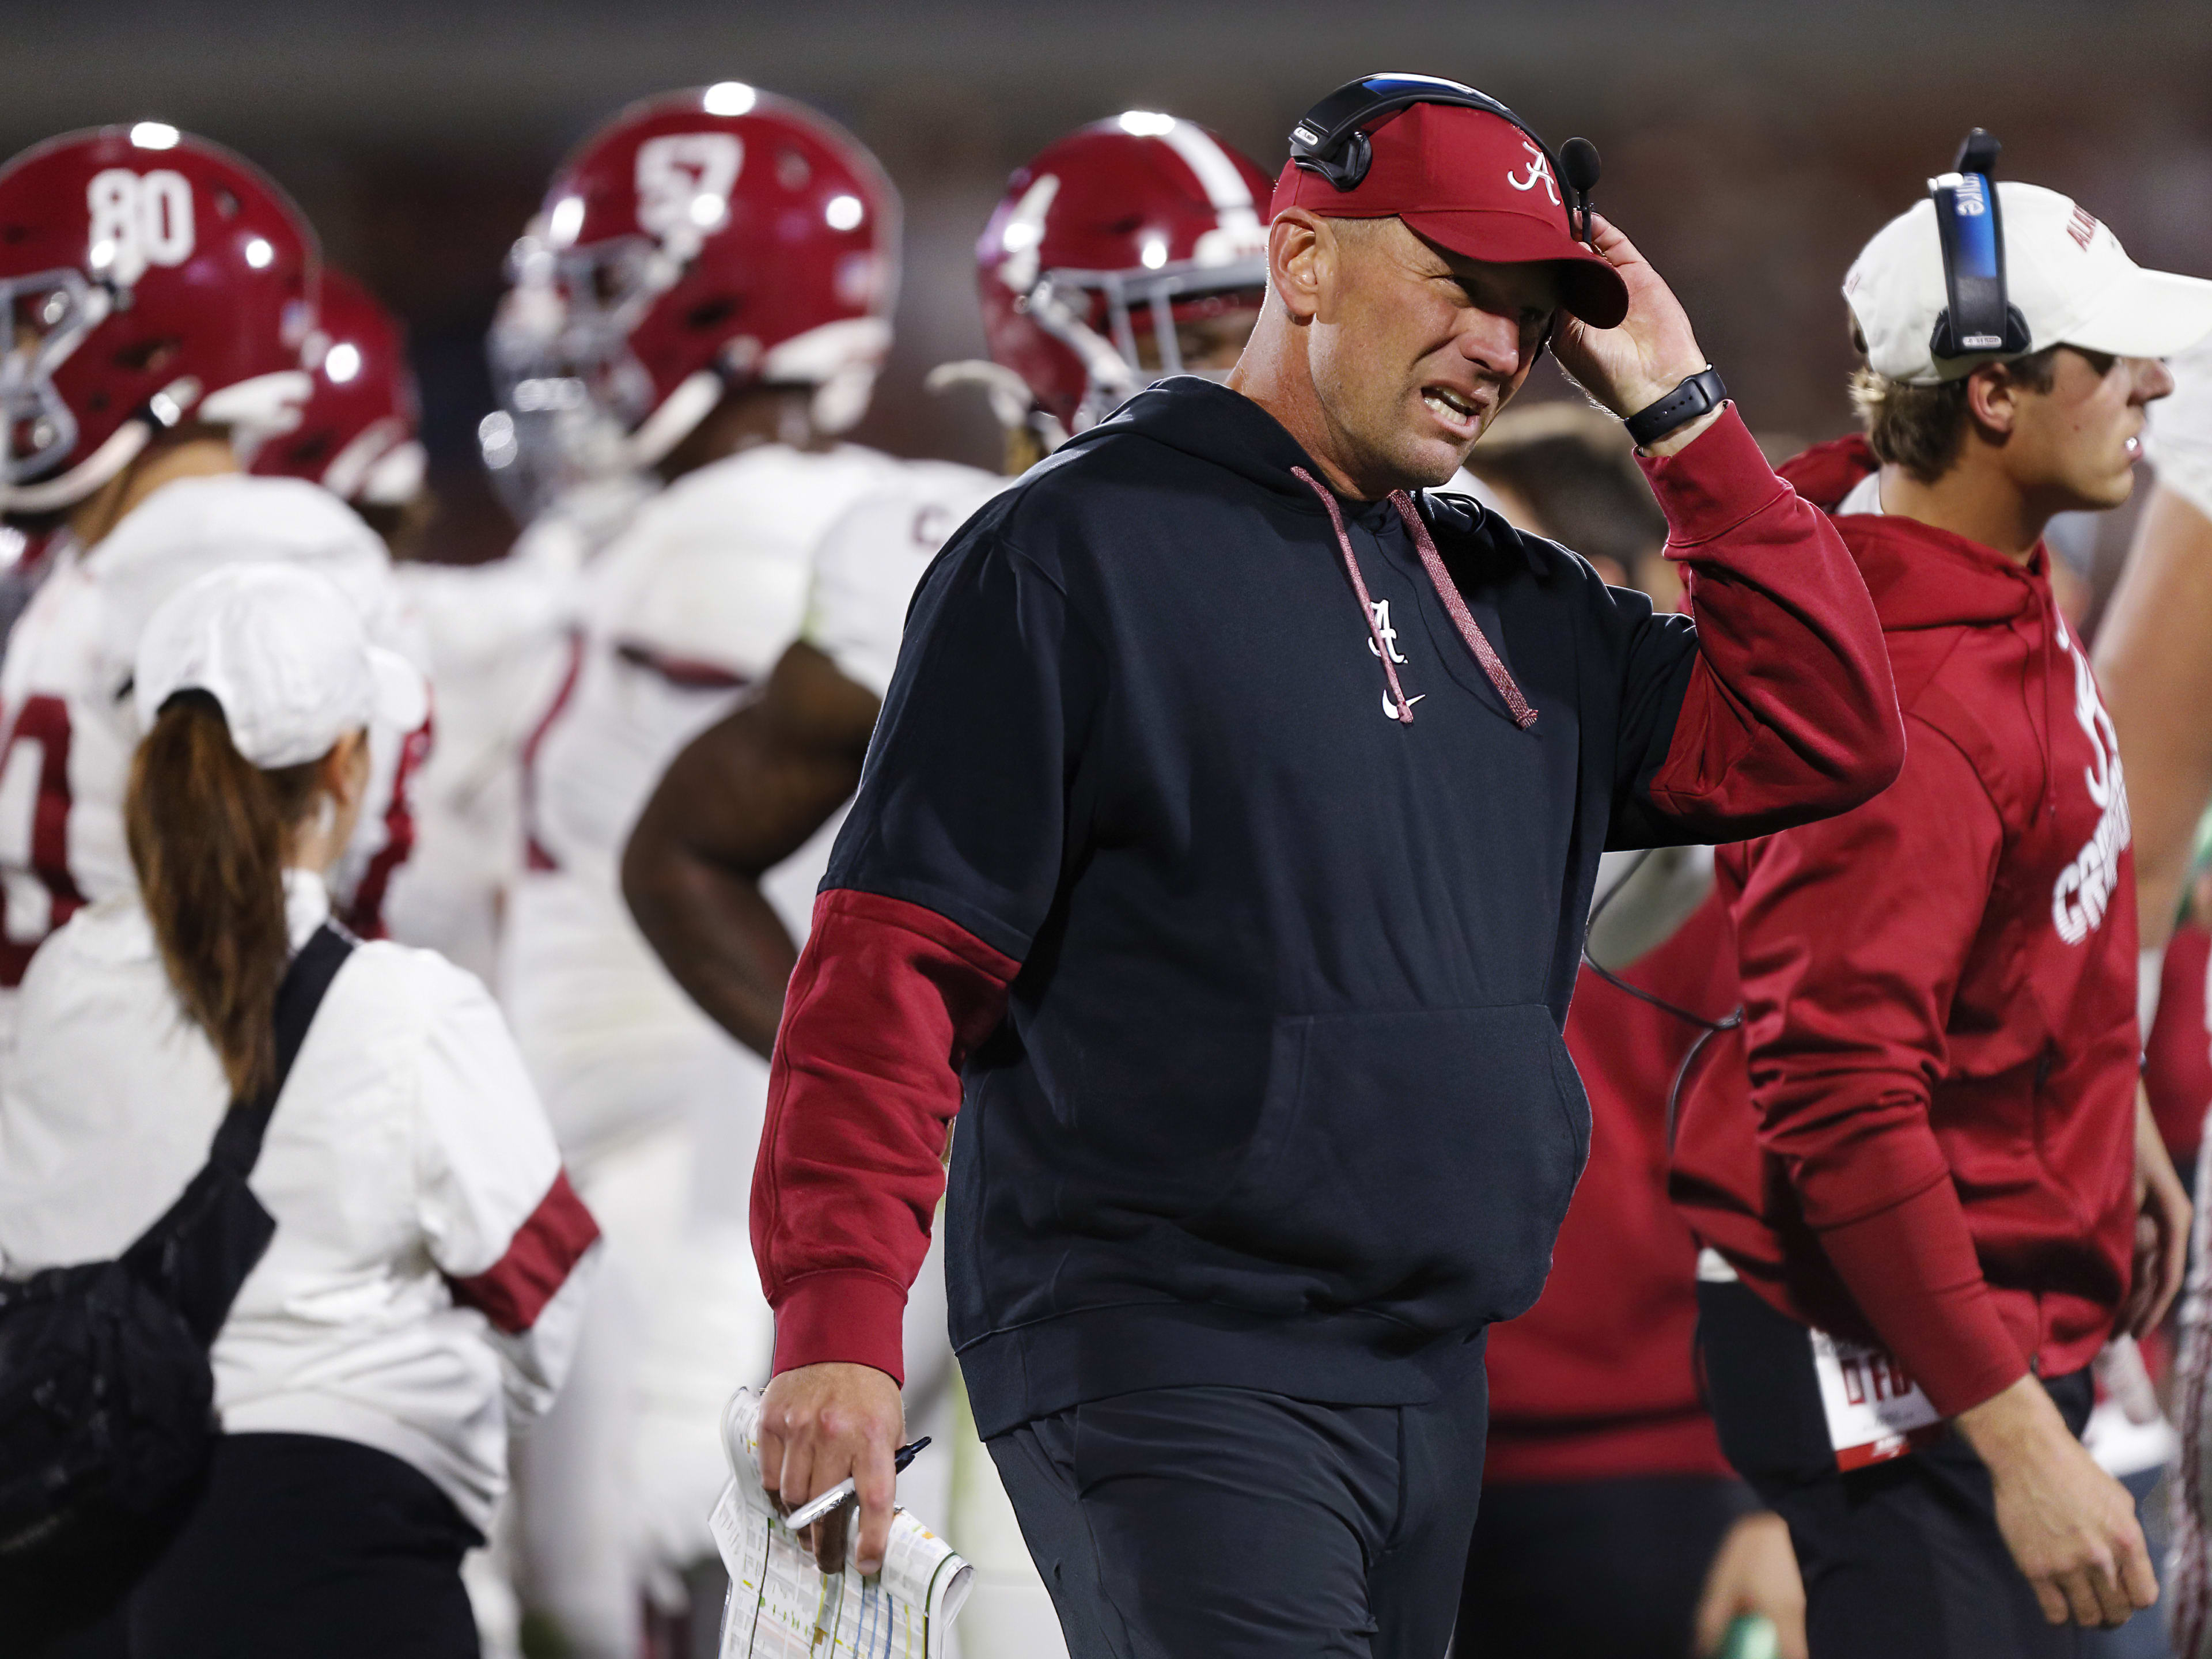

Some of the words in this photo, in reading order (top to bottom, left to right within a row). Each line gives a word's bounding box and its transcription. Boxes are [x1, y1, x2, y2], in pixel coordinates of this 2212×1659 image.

[1507, 141, 1561, 206] A
[87, 168, 195, 274] 80
[1368, 599, 1409, 664] A
